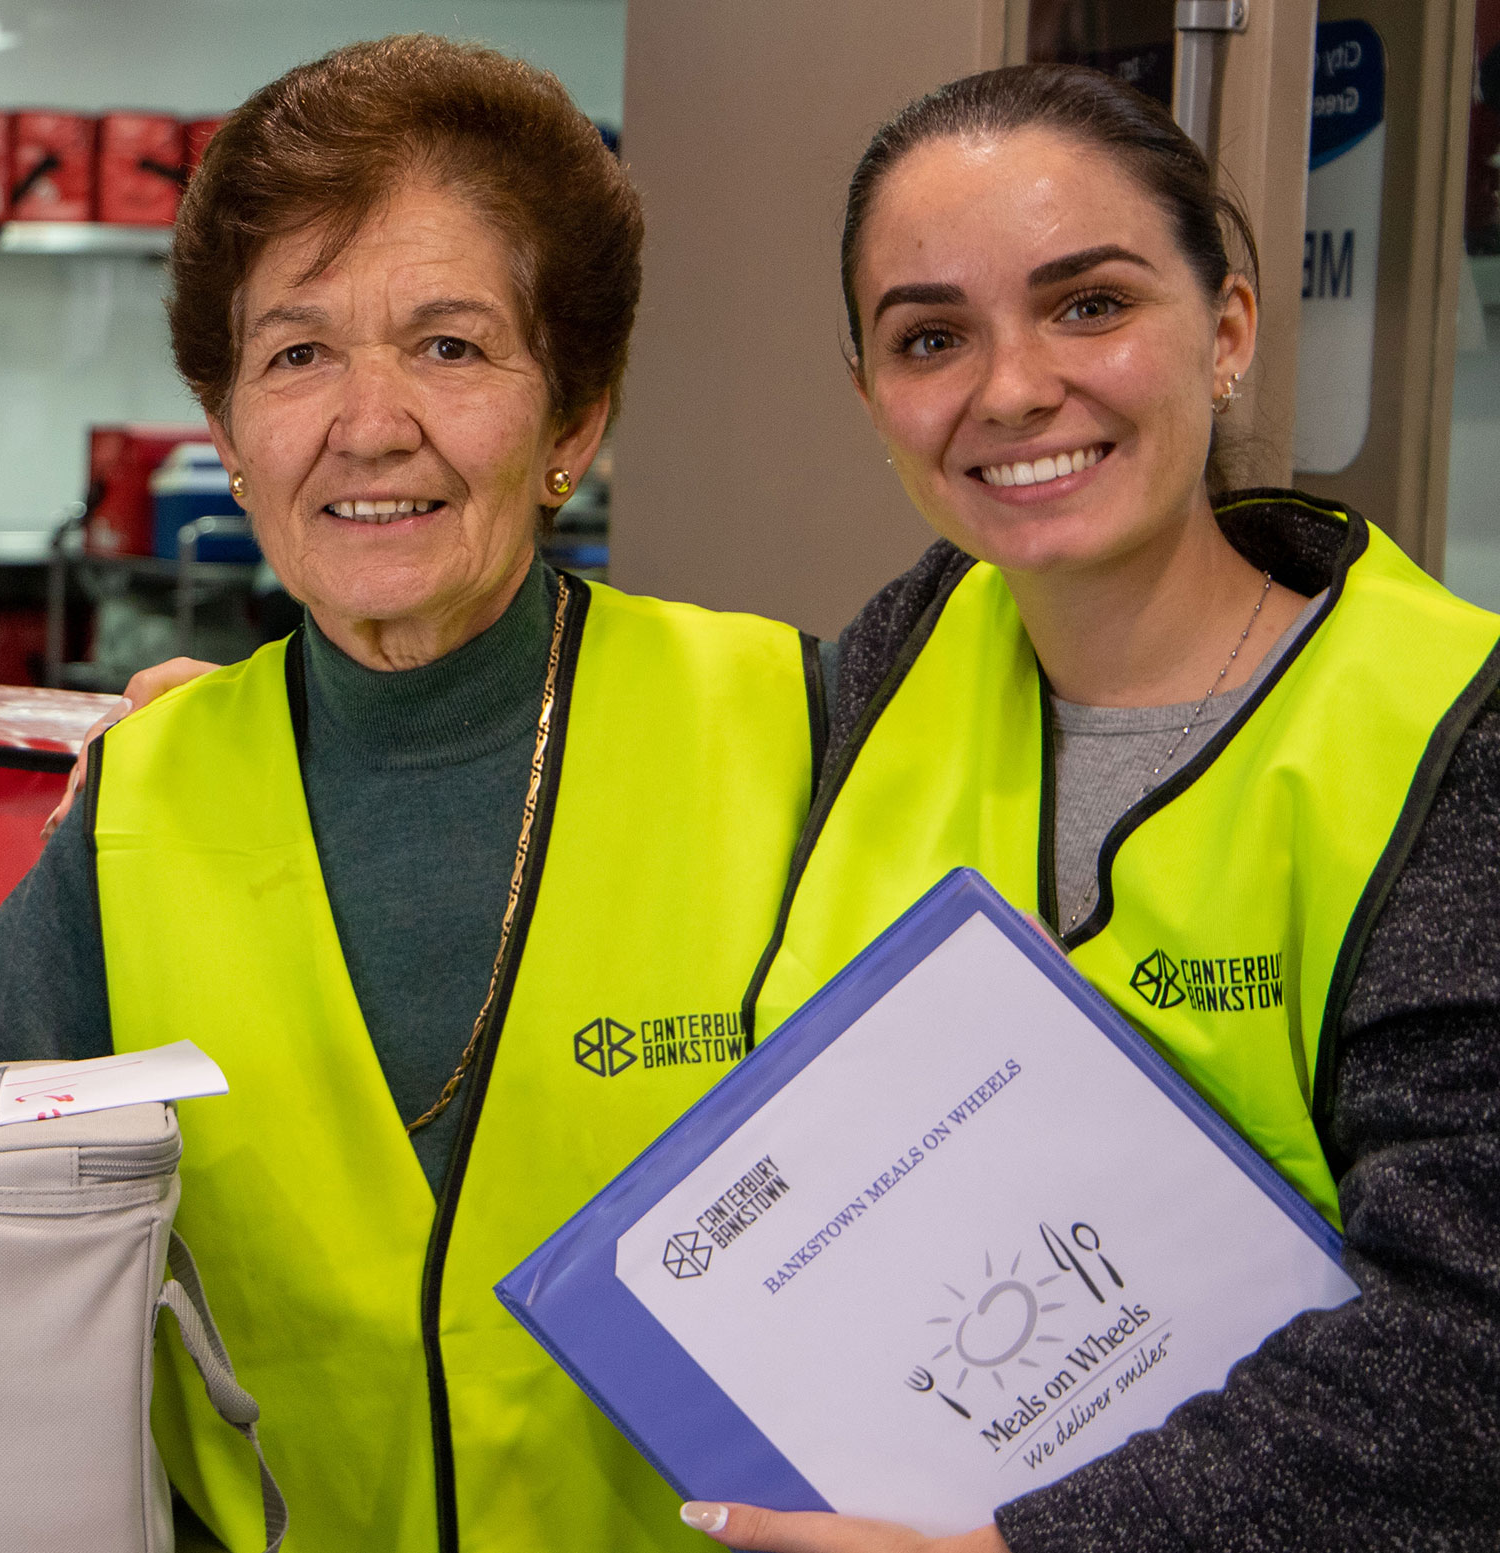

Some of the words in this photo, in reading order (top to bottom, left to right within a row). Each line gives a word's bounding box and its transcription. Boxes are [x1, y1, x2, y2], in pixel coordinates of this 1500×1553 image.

[696, 1154, 779, 1234] CANTERBURY
[711, 1175, 790, 1250] BANKSTOWN
[763, 1196, 869, 1295] BANKSTOWN
[864, 1146, 925, 1203] MEALS
[922, 1121, 952, 1150] ON
[947, 1058, 1022, 1126] WHEELS
[980, 1395, 1047, 1453] Meals
[1044, 1369, 1077, 1400] on
[1065, 1304, 1151, 1372] Wheels
[1023, 1441, 1055, 1470] We
[1056, 1386, 1112, 1446] deliver
